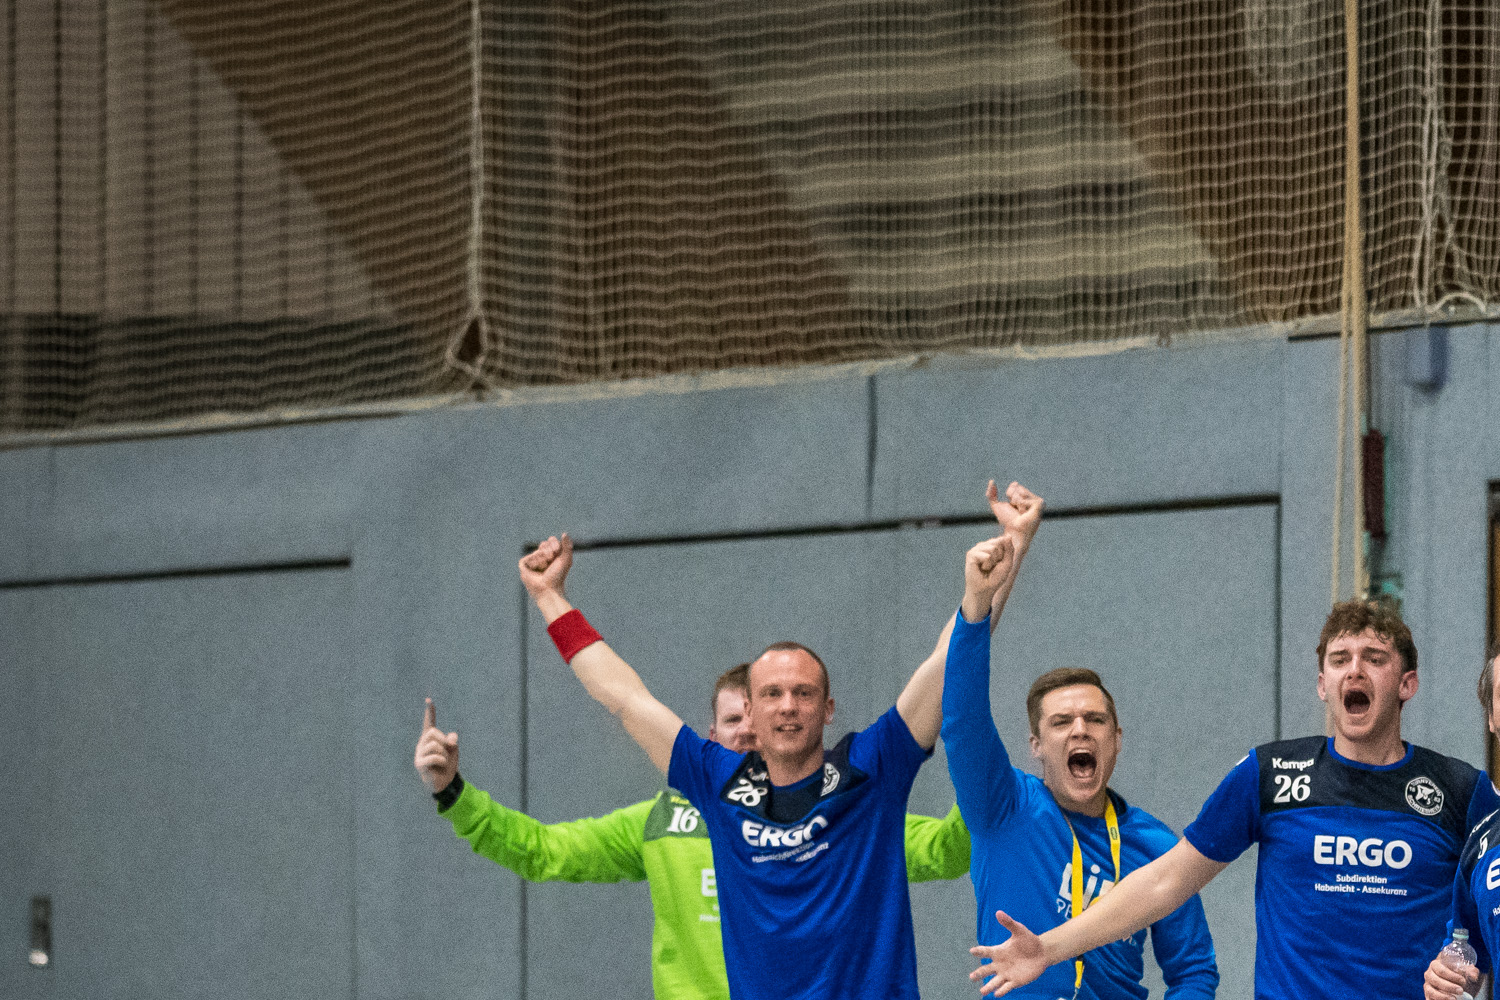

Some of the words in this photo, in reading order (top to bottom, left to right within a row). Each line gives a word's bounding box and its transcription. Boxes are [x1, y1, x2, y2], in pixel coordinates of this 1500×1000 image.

[1272, 757, 1315, 771] Kempa
[727, 778, 769, 807] 28
[1273, 775, 1312, 803] 26
[667, 806, 701, 833] 16
[1313, 835, 1412, 869] ERGO
[1314, 882, 1355, 894] Habenicht
[1361, 885, 1408, 896] Assekuranz
[1335, 873, 1387, 885] Subdirektion
